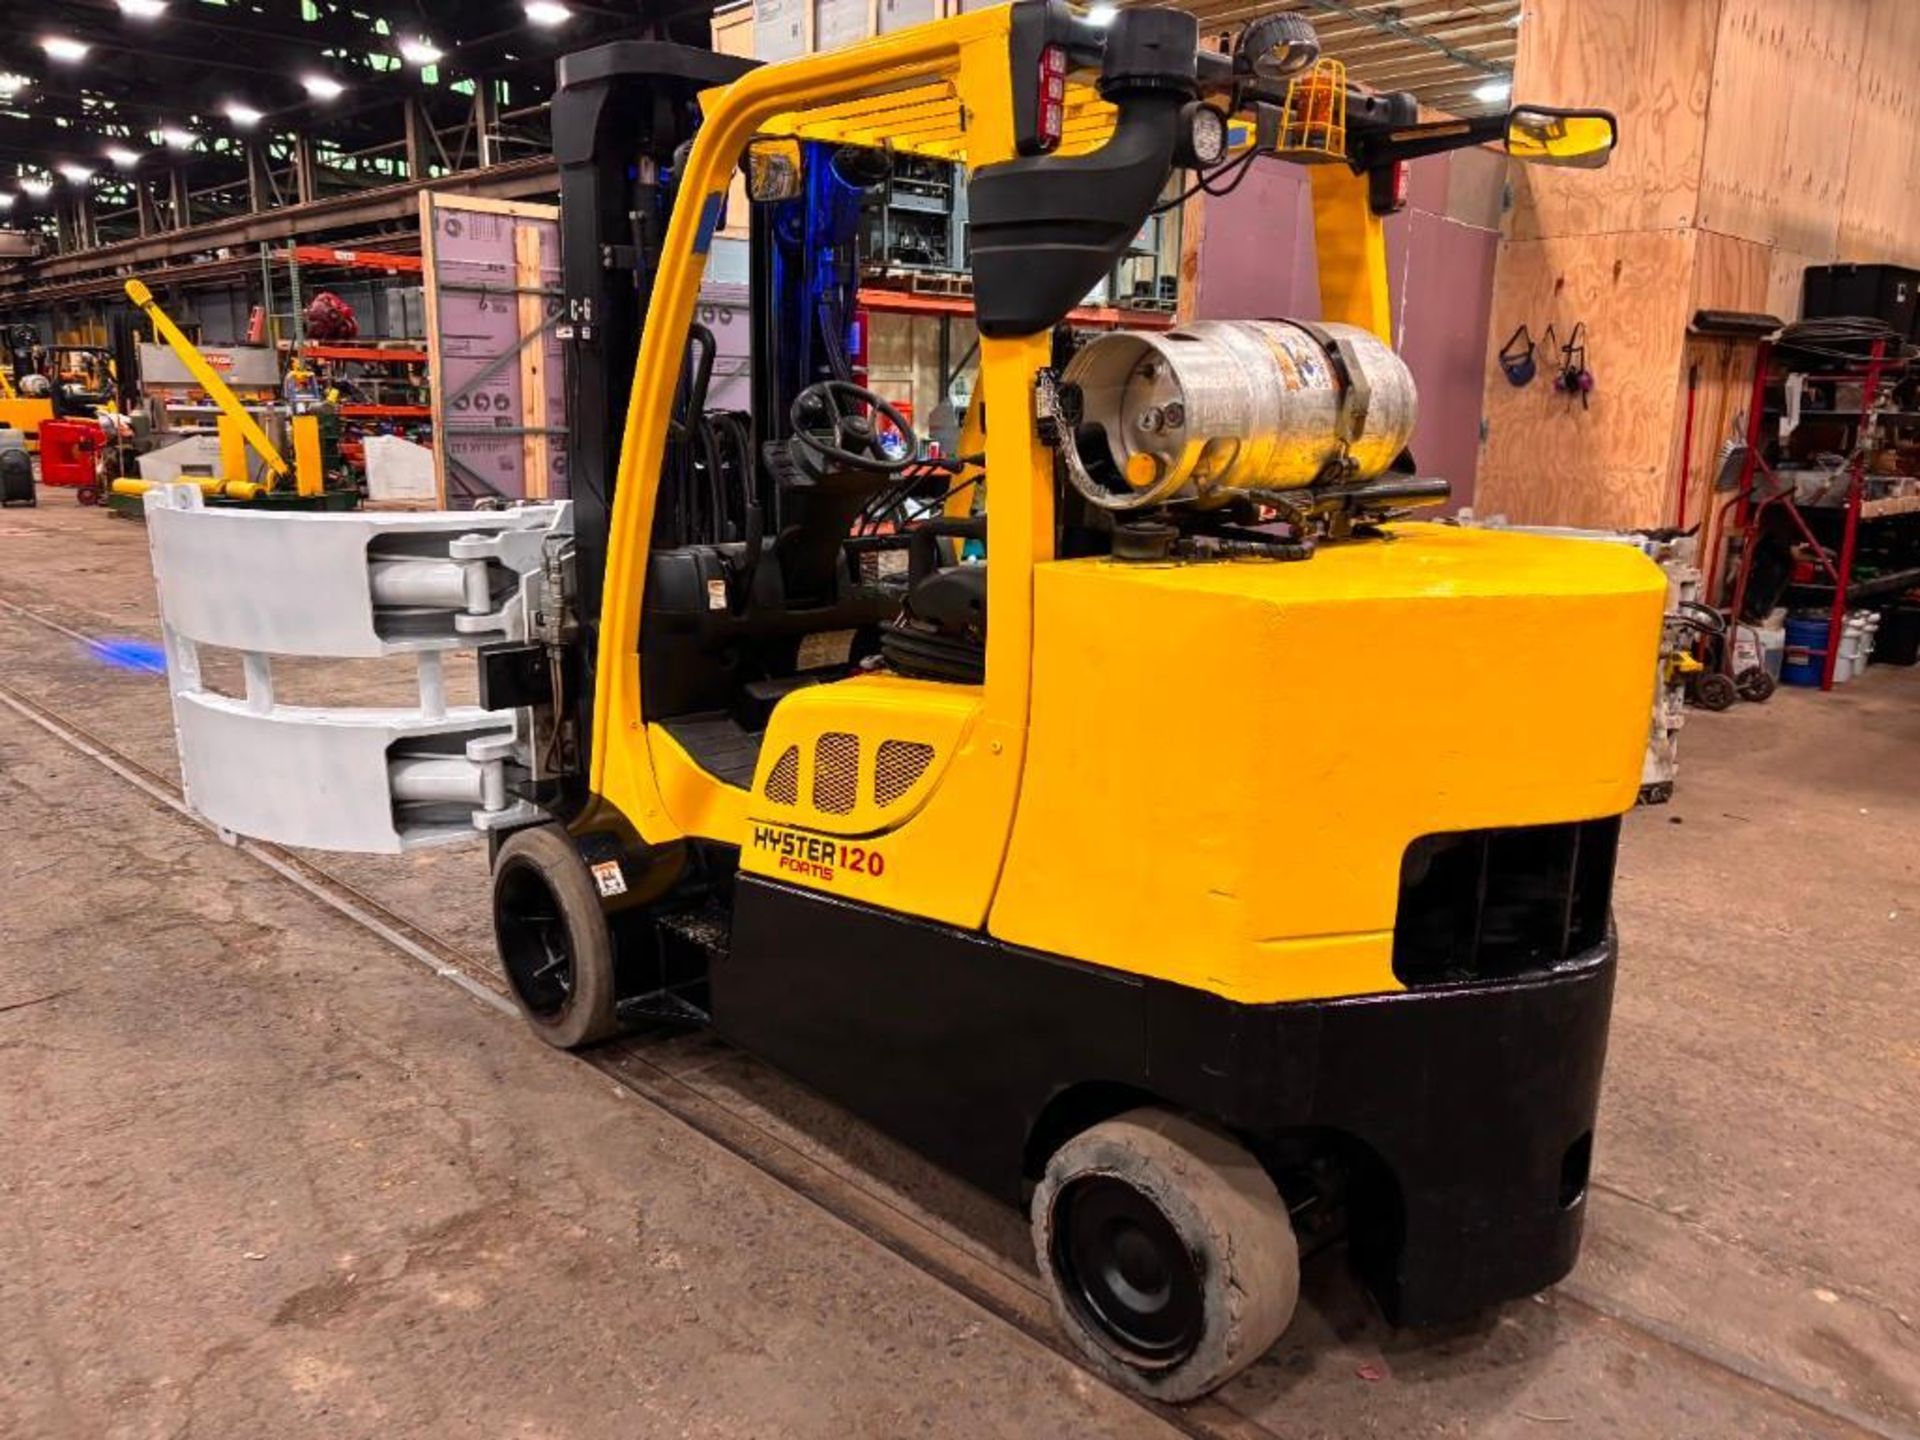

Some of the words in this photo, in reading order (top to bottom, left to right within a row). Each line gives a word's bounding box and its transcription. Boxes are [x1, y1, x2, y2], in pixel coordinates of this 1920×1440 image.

[754, 827, 836, 866] HYSTER
[840, 845, 885, 877] 120
[779, 855, 834, 881] FORTIS
